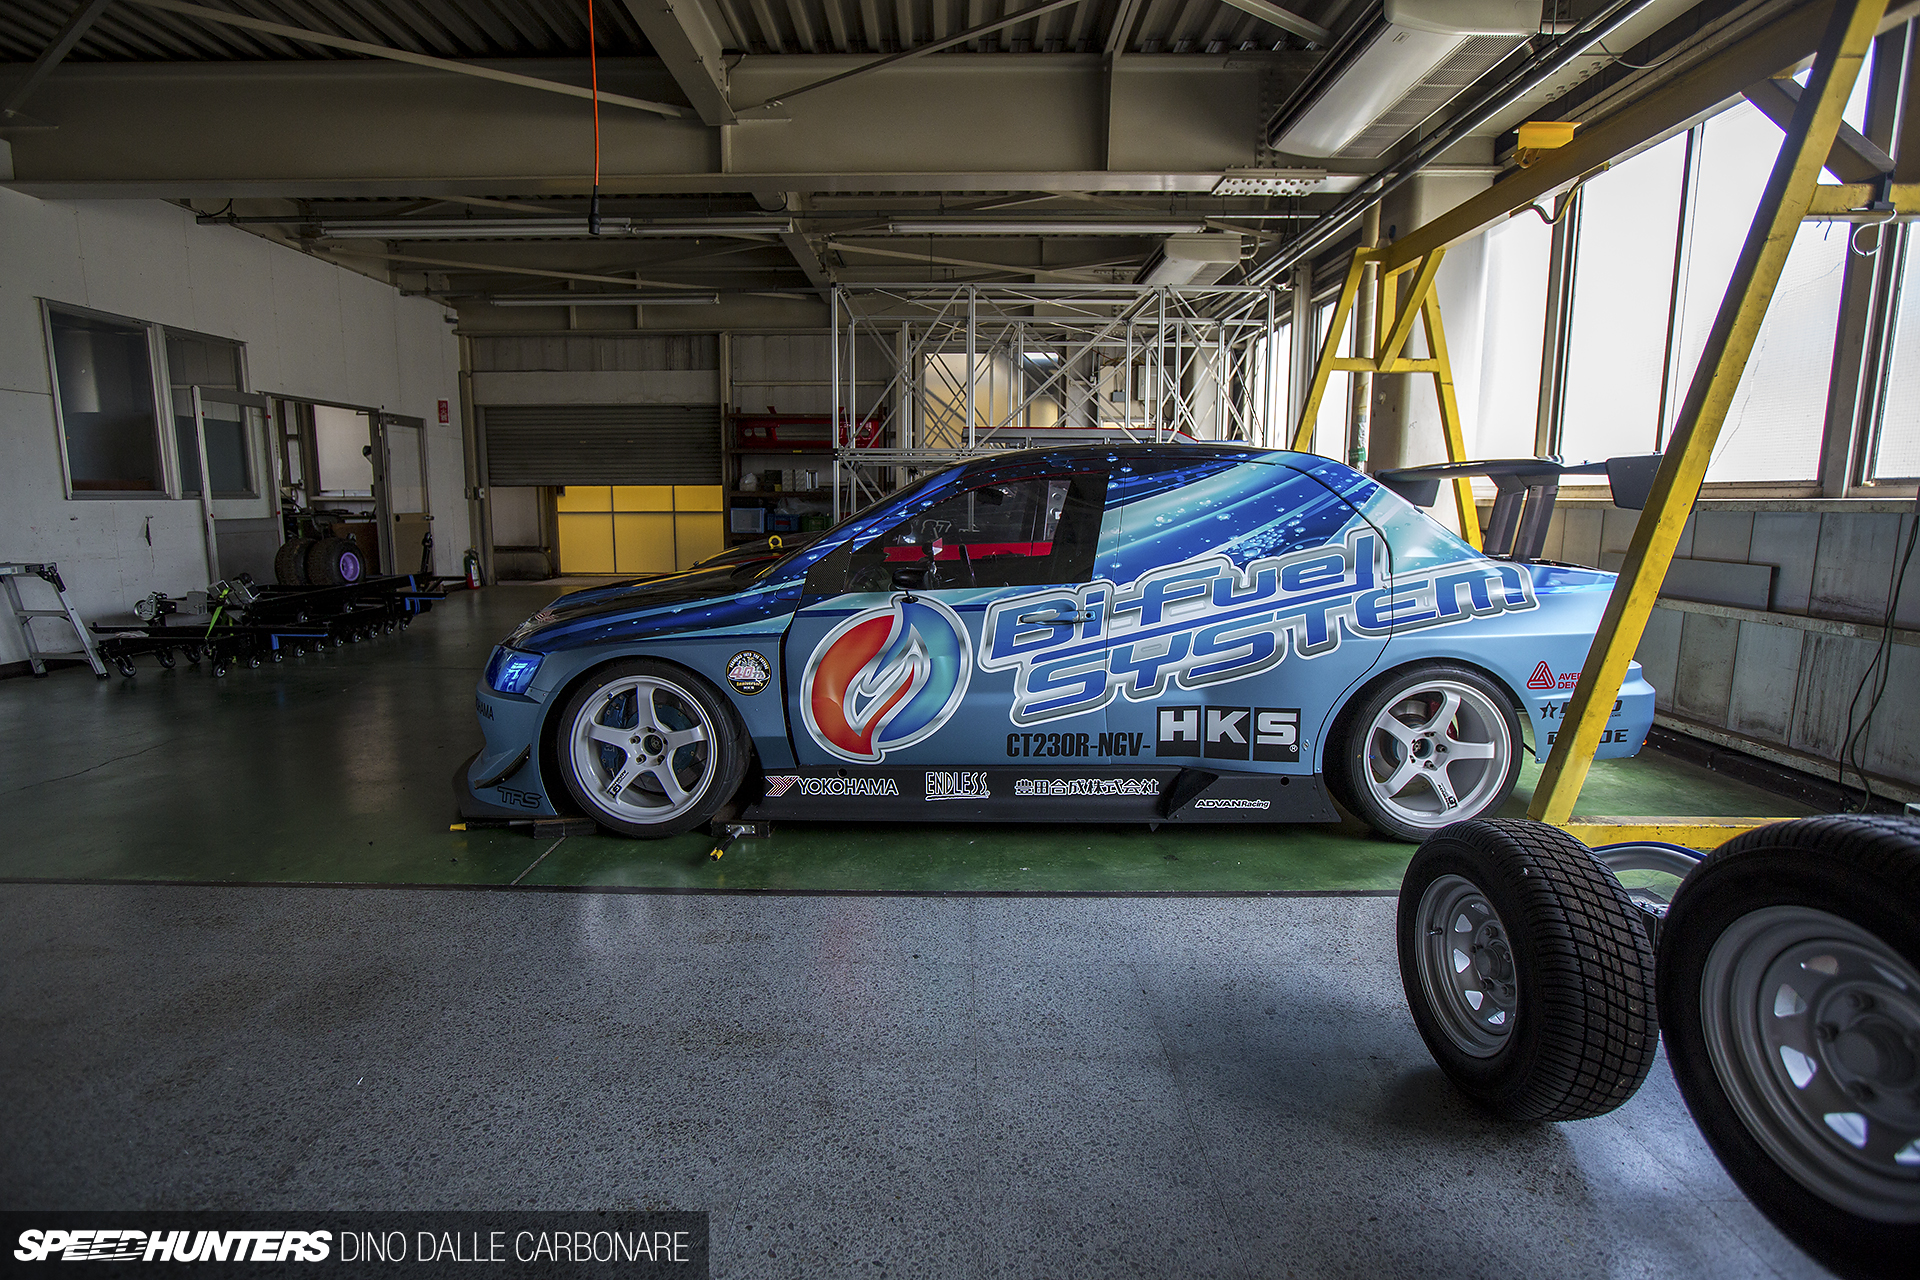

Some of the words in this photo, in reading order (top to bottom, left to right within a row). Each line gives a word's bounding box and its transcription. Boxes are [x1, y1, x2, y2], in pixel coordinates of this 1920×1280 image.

[1158, 708, 1299, 749] HKS
[1006, 732, 1151, 757] CT230R-NGV-
[798, 778, 899, 795] YOKOHAMA
[925, 771, 988, 796] ENDLESS
[1014, 779, 1159, 796] 豊田合成株式会社
[497, 786, 543, 809] TRS
[1195, 799, 1240, 809] ADVAN
[1240, 799, 1270, 810] Racing
